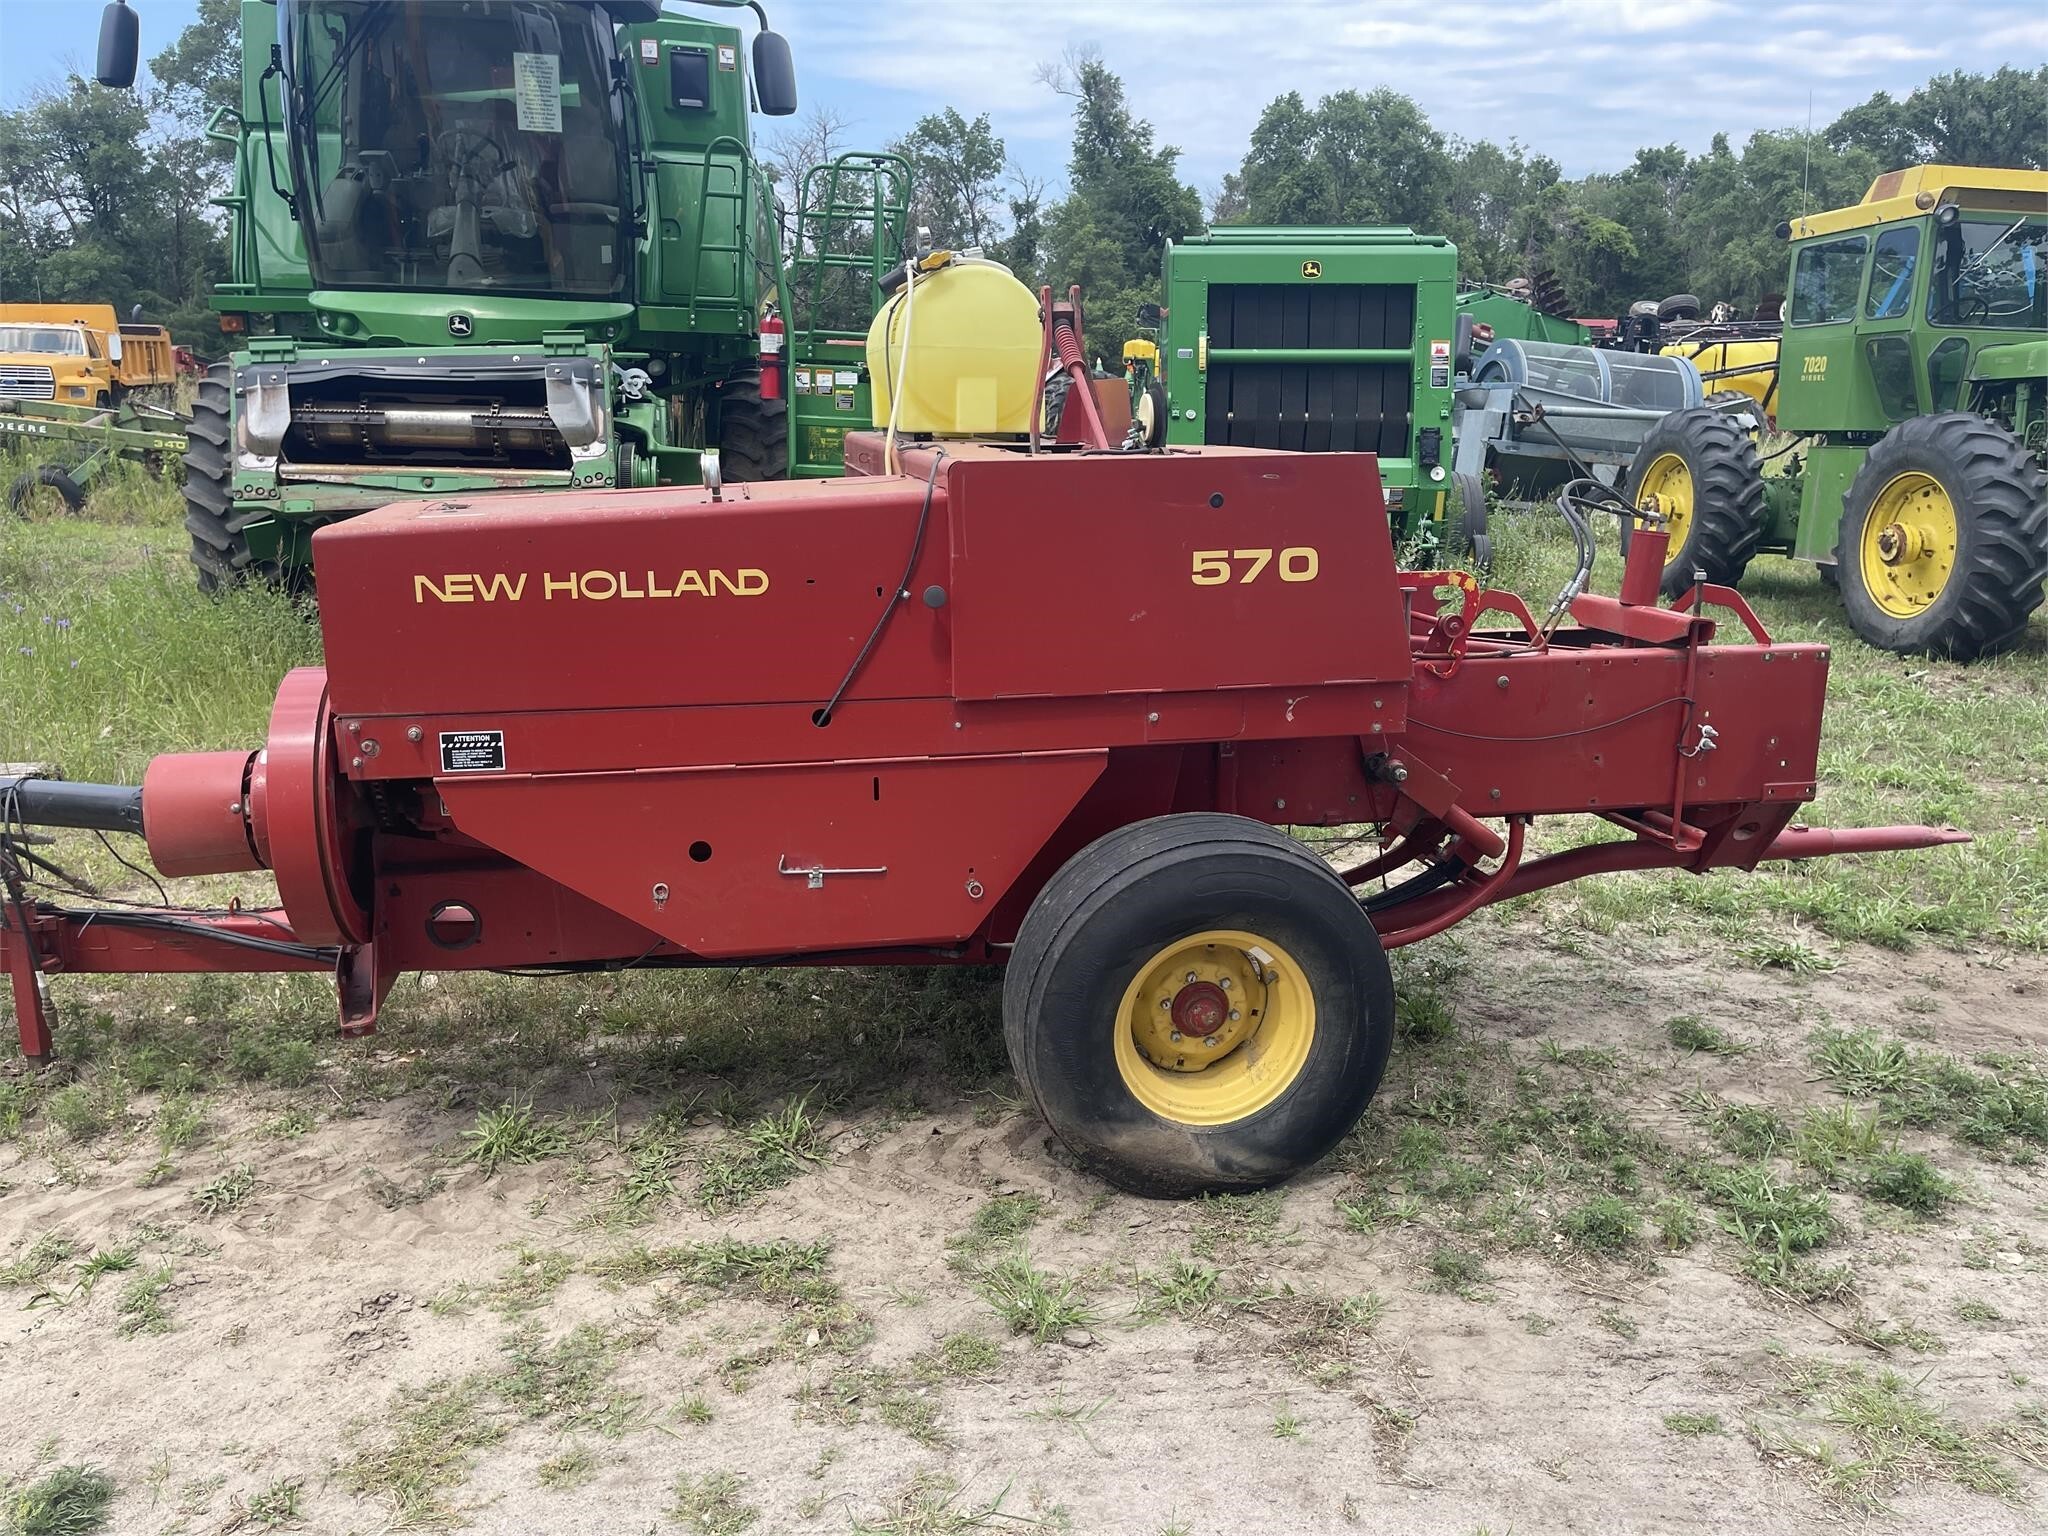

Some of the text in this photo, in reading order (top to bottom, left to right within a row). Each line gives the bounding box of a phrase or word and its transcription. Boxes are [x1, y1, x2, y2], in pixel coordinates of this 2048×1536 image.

[1803, 356, 1827, 373] 7020
[1801, 374, 1825, 382] DIESEL
[0, 421, 47, 434] DEERE
[153, 439, 186, 450] 340
[1191, 546, 1319, 585] 570
[413, 568, 770, 603] NEW HOLLAND
